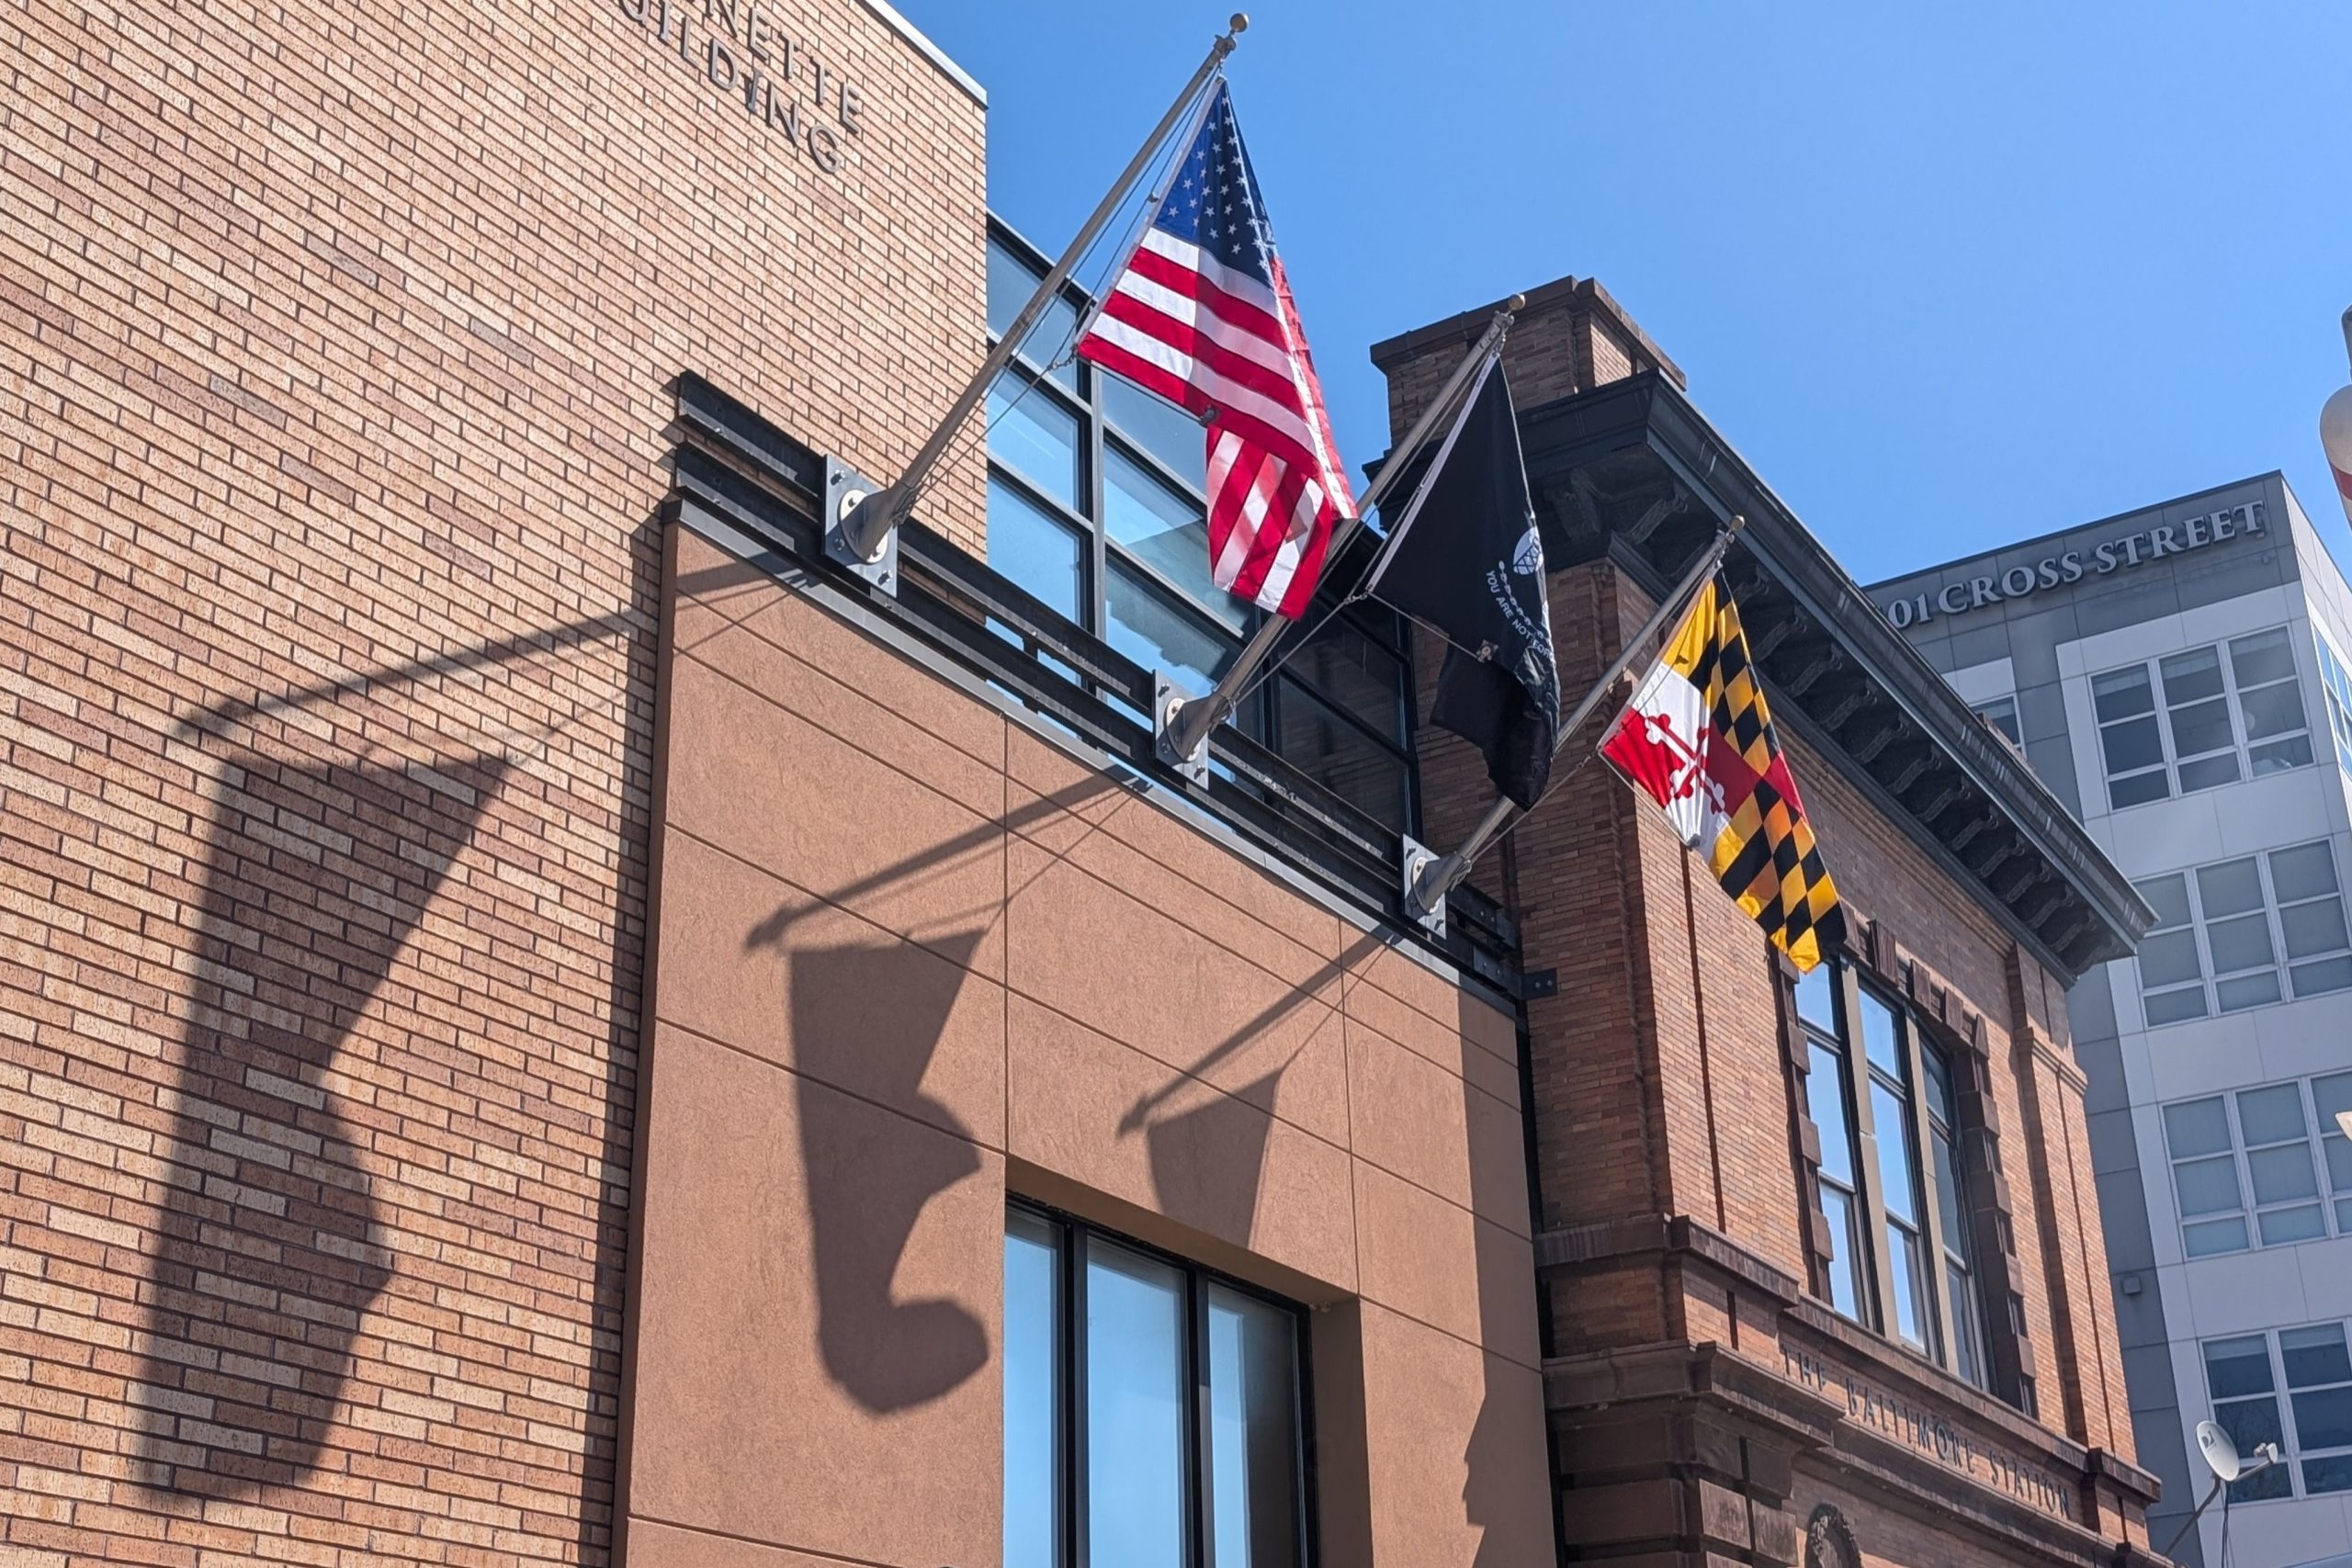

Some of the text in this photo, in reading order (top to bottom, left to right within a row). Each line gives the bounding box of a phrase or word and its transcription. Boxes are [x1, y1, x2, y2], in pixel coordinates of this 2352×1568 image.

[1486, 570, 1501, 593] YOU
[1496, 596, 1514, 619] ARE
[1511, 619, 1532, 639] NOT
[1938, 550, 2085, 614] CROSS
[2095, 500, 2265, 574] STREET
[1846, 1377, 1975, 1473] BALTIMORE
[1988, 1450, 2070, 1518] STATION
